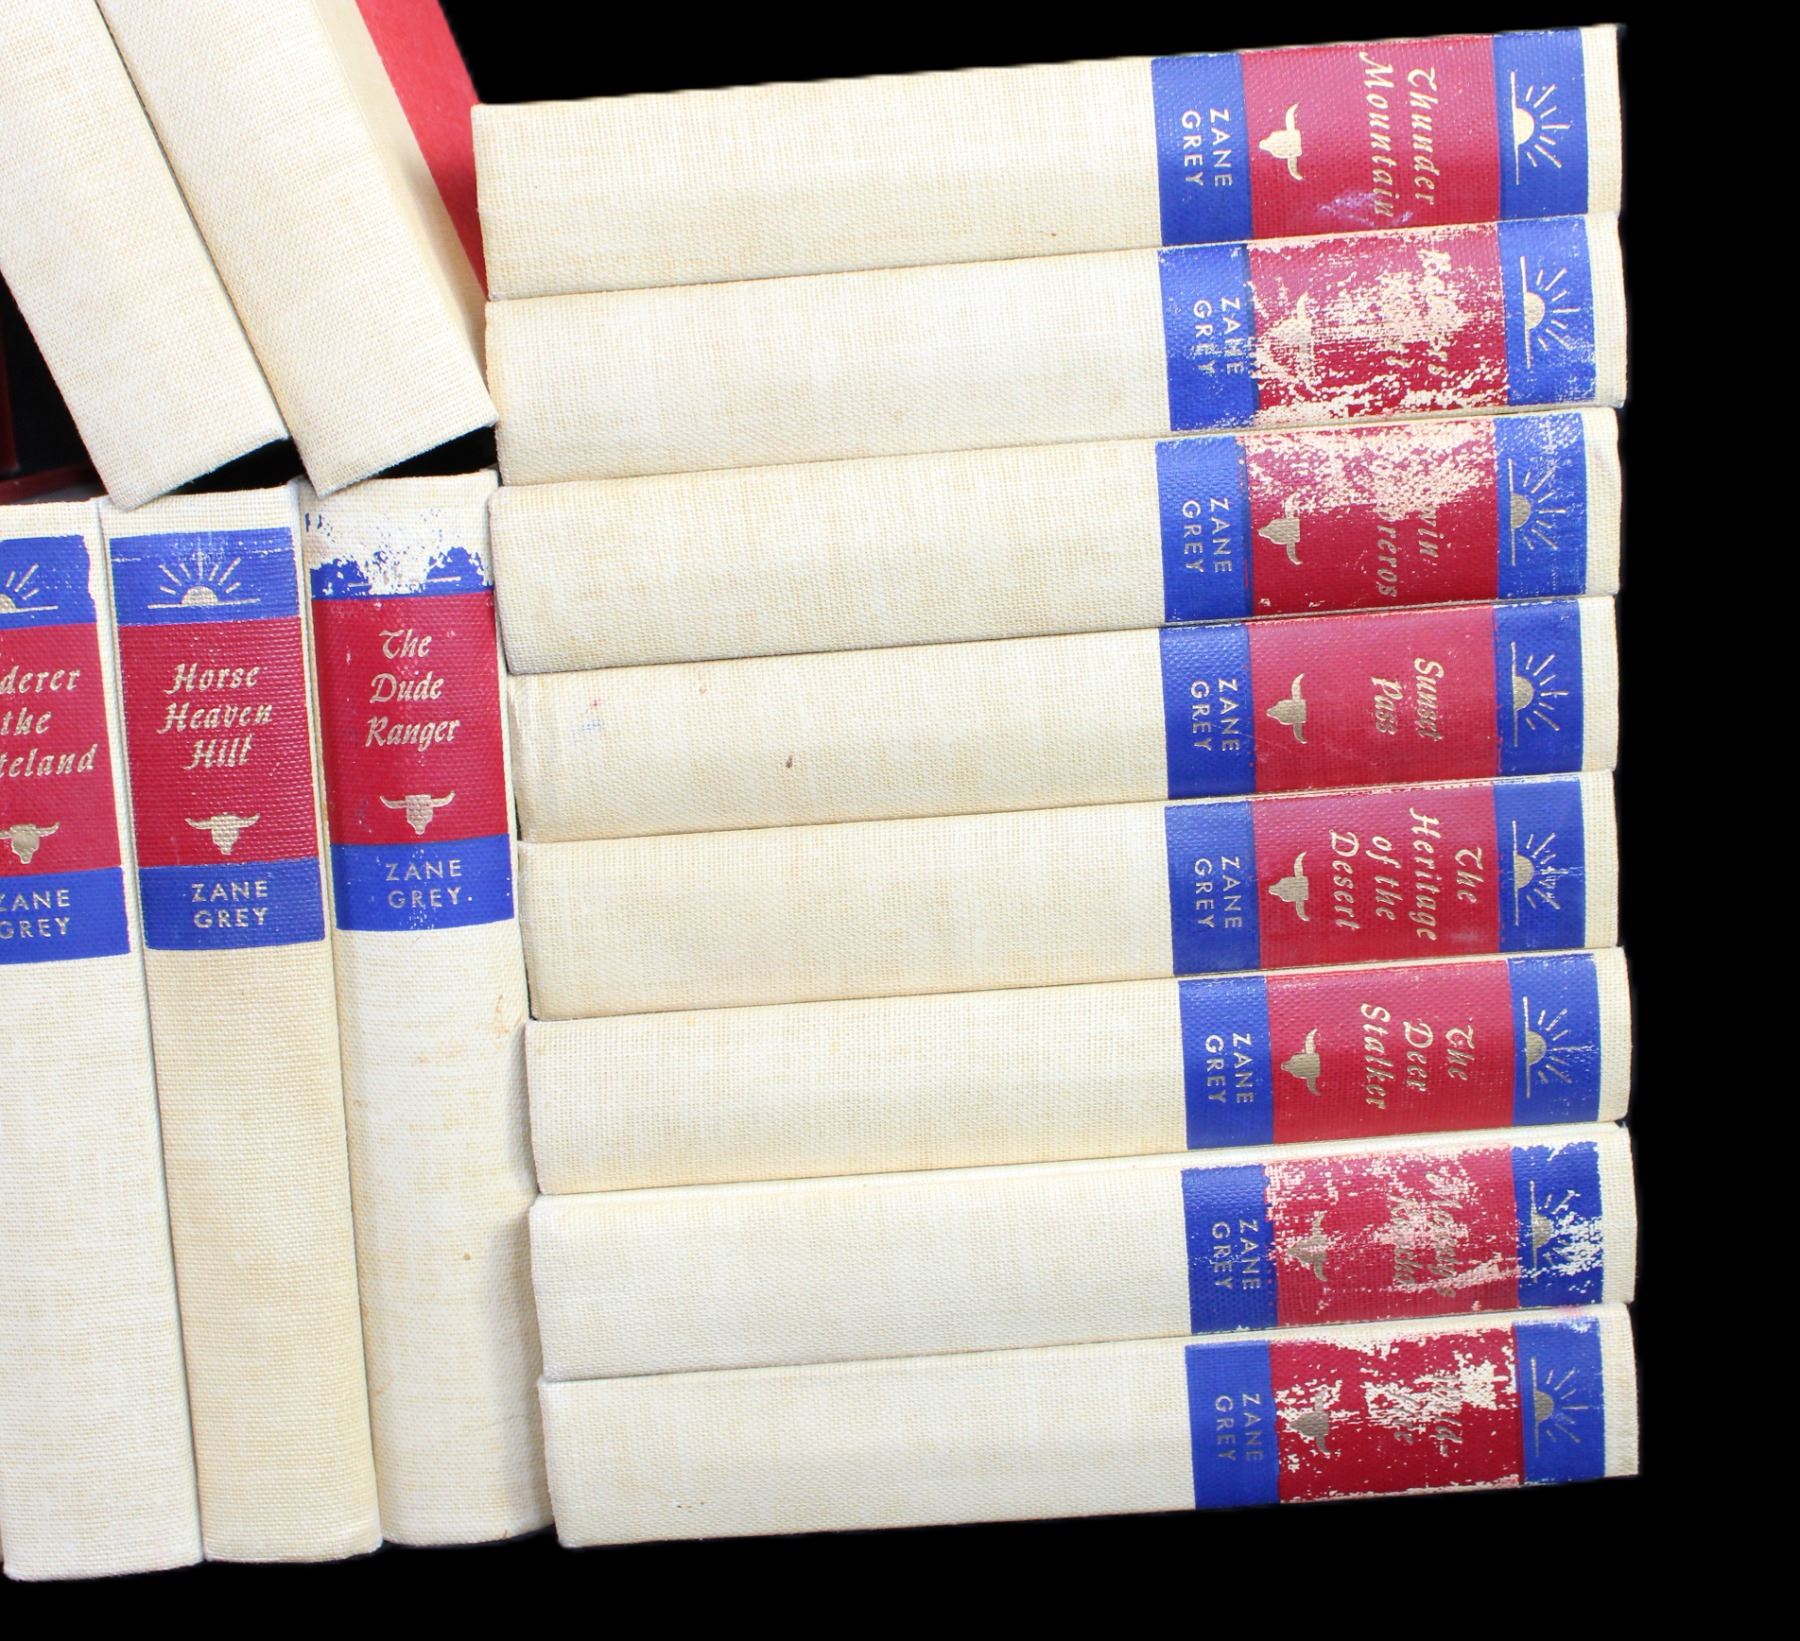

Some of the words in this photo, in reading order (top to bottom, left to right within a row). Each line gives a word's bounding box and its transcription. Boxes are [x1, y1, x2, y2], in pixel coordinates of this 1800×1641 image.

[1181, 109, 1204, 187] GREY
[1209, 108, 1233, 187] ZANE
[1359, 51, 1400, 217] Mountain
[1407, 67, 1440, 205] Thunder
[1193, 300, 1216, 375] GREY
[1220, 297, 1244, 375] ZANE
[1182, 500, 1205, 574] GREY
[1209, 497, 1233, 574] ZANE
[378, 629, 430, 657] The
[164, 663, 260, 695] Horse
[370, 671, 443, 704] Dude
[1370, 676, 1404, 735] Pass
[1413, 657, 1445, 742] Sunset
[1, 711, 51, 738] the
[157, 699, 273, 734] Heaven
[365, 717, 462, 753] Ranger
[1190, 681, 1212, 752] GREY
[1218, 678, 1240, 752] ZANE
[184, 733, 254, 771] Hill
[384, 859, 464, 881] ZANE
[1328, 829, 1361, 929] Desert
[1365, 835, 1400, 870] of
[1408, 807, 1443, 941] Heritage
[1454, 847, 1485, 904] The
[191, 880, 269, 903] ZANE
[194, 907, 269, 930] GREY
[388, 887, 461, 910] GREY
[1194, 858, 1215, 929] GREY
[1220, 856, 1243, 929] ZANE
[1375, 876, 1406, 921] the
[0, 917, 70, 940] GREY
[1204, 1034, 1227, 1104] GREY
[1232, 1032, 1254, 1104] ZANE
[1360, 1002, 1397, 1110] Stalker
[1402, 1017, 1434, 1092] Deer
[1444, 1024, 1477, 1081] The
[1211, 1221, 1233, 1290] GREY
[1239, 1219, 1261, 1290] ZANE
[1214, 1395, 1237, 1462] GREY
[1241, 1393, 1264, 1462] ZANE
